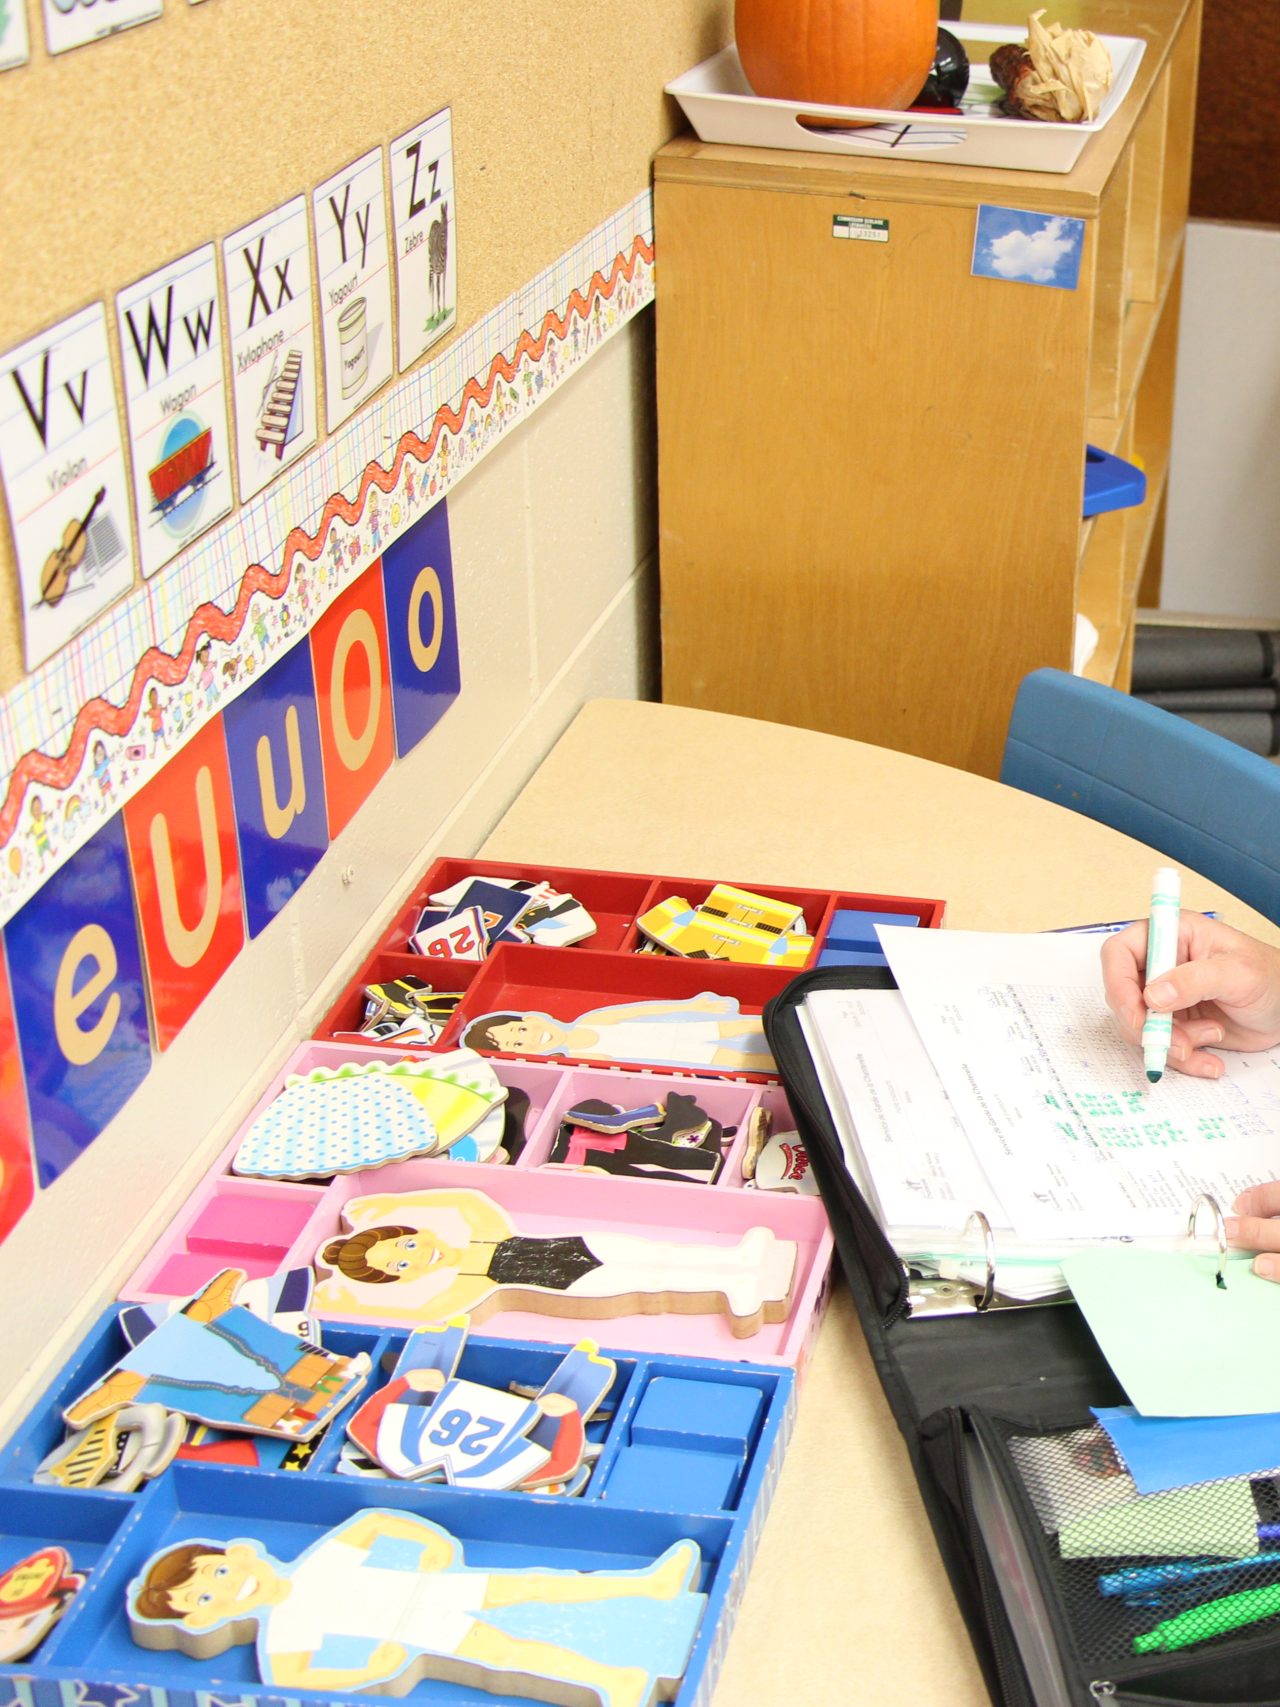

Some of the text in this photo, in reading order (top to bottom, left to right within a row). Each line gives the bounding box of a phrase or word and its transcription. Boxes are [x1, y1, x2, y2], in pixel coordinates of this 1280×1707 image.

[159, 383, 197, 415] Wagon
[47, 456, 88, 491] Violon
[428, 1408, 506, 1457] 26
